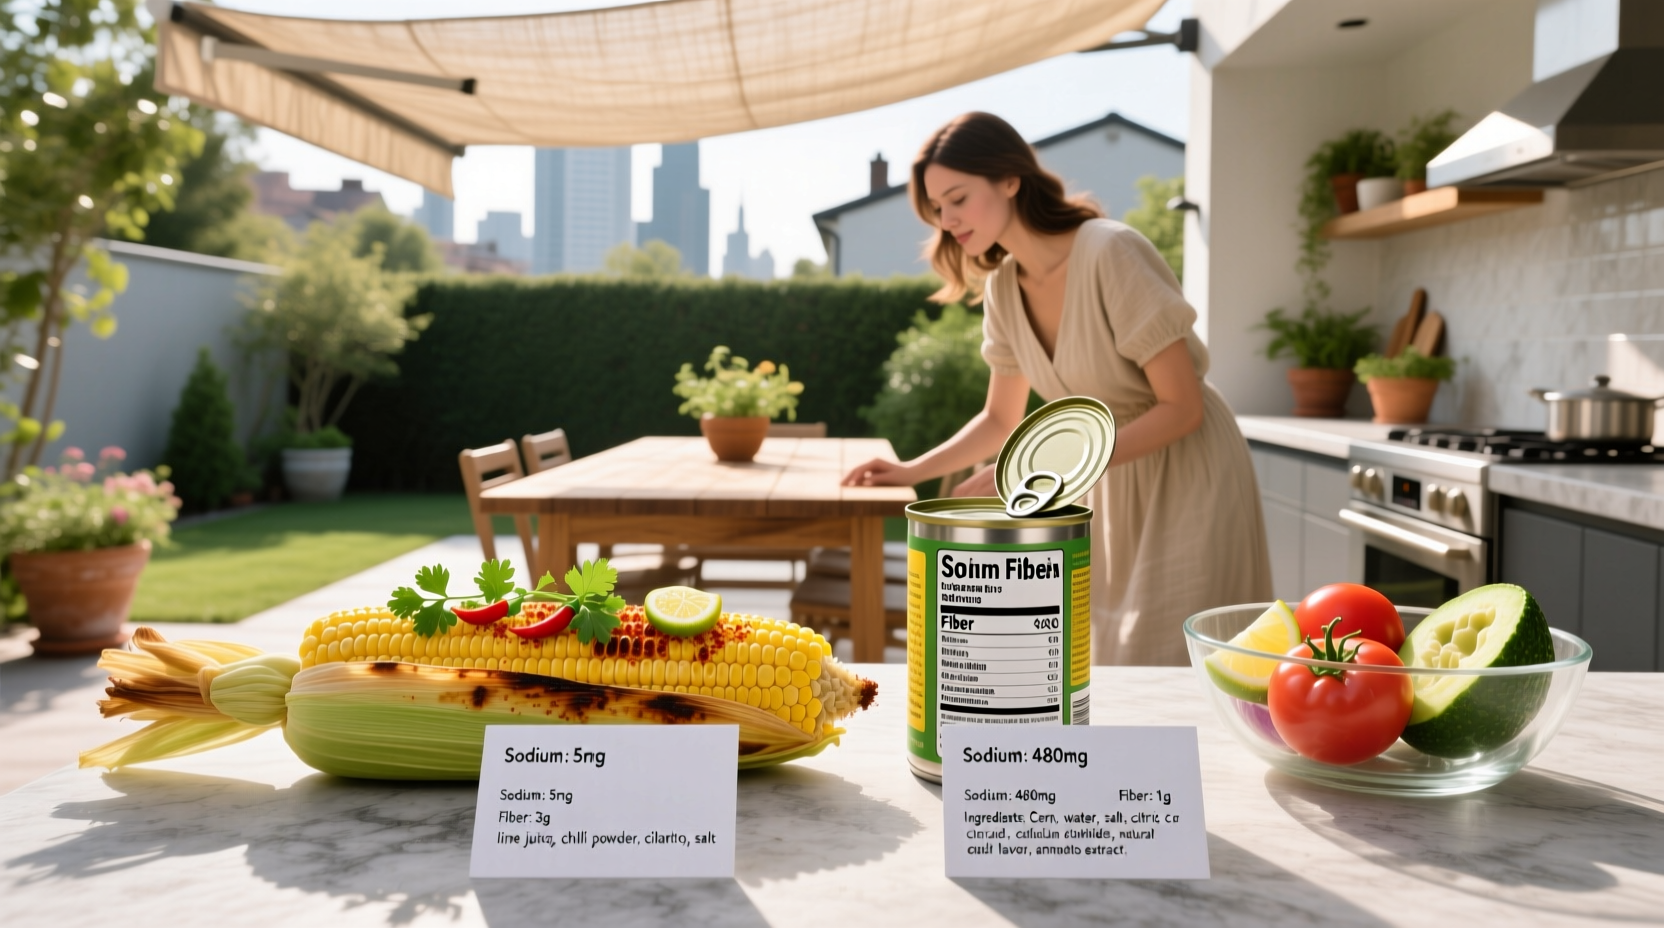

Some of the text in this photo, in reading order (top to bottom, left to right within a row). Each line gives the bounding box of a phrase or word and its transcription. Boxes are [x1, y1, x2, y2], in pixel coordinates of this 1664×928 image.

[505, 747, 569, 763] Sodium:
[963, 747, 1088, 768] Sodium: 480mg
[1156, 791, 1171, 805] 1g
[535, 812, 550, 825] 3g
[592, 832, 641, 848] powder,
[694, 832, 716, 844] salt
